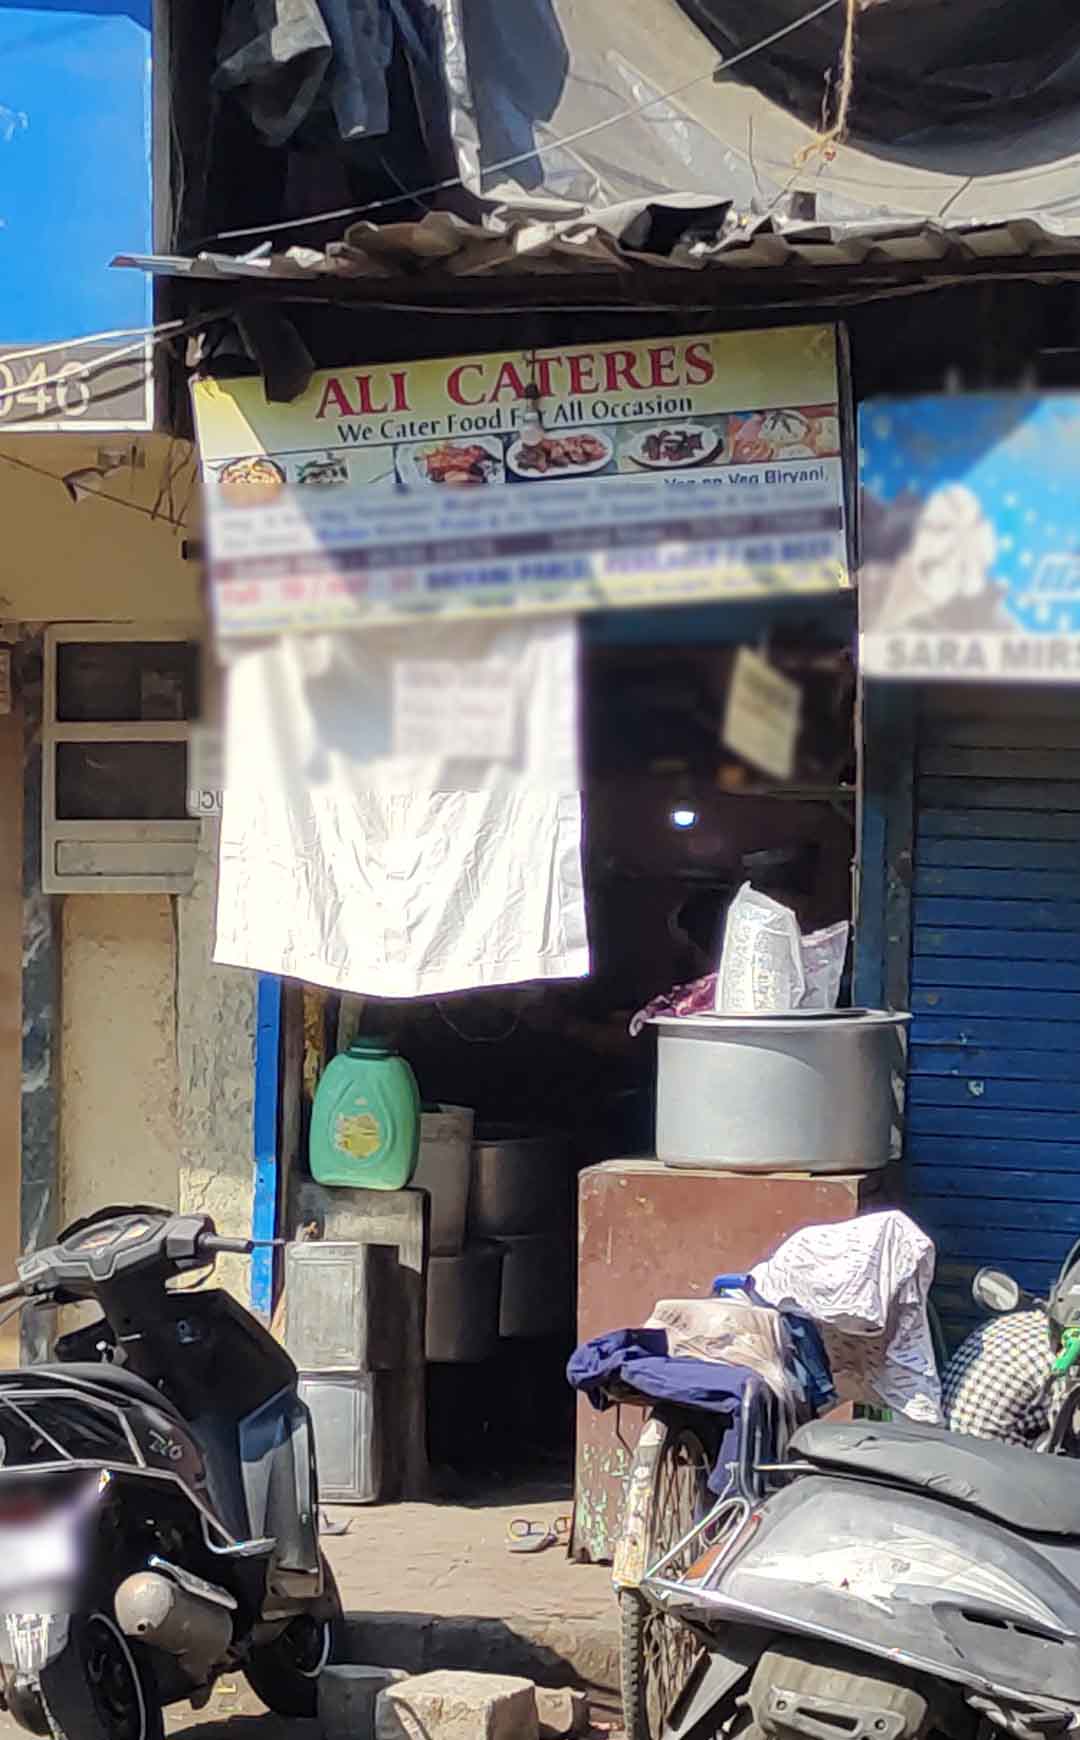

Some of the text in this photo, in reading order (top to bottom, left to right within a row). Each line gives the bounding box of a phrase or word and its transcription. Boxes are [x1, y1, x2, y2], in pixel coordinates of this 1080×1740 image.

[315, 342, 715, 419] ALI CATERES
[337, 395, 693, 443] We Cater Food Fr All Occasion
[1001, 639, 1080, 670] MIR
